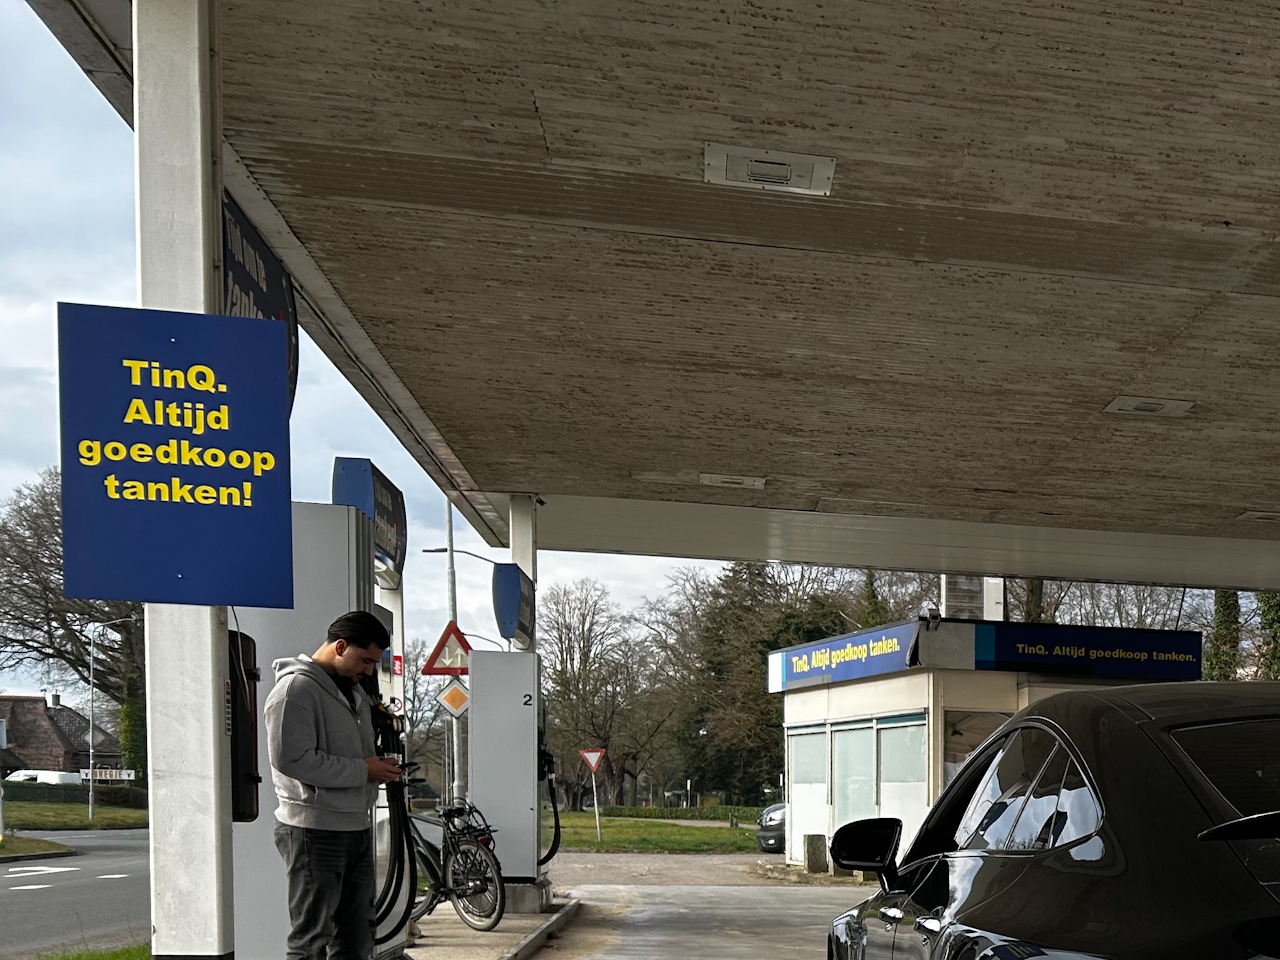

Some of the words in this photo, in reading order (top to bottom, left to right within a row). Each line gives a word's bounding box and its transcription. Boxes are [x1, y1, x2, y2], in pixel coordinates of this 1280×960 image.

[122, 359, 228, 393] TinQ.
[123, 398, 230, 435] Altijd
[78, 438, 276, 477] goedkoop
[104, 474, 252, 507] tanken!
[792, 655, 810, 673] TinQ.
[811, 648, 830, 670] Altijd
[831, 643, 868, 669] goedkoop
[869, 636, 900, 656] tanken.
[1016, 644, 1049, 655] TinQ.
[1052, 645, 1086, 659] Altijd
[1089, 648, 1149, 662] goedkoop
[1152, 651, 1197, 662] tanken.
[523, 693, 533, 706] 2
